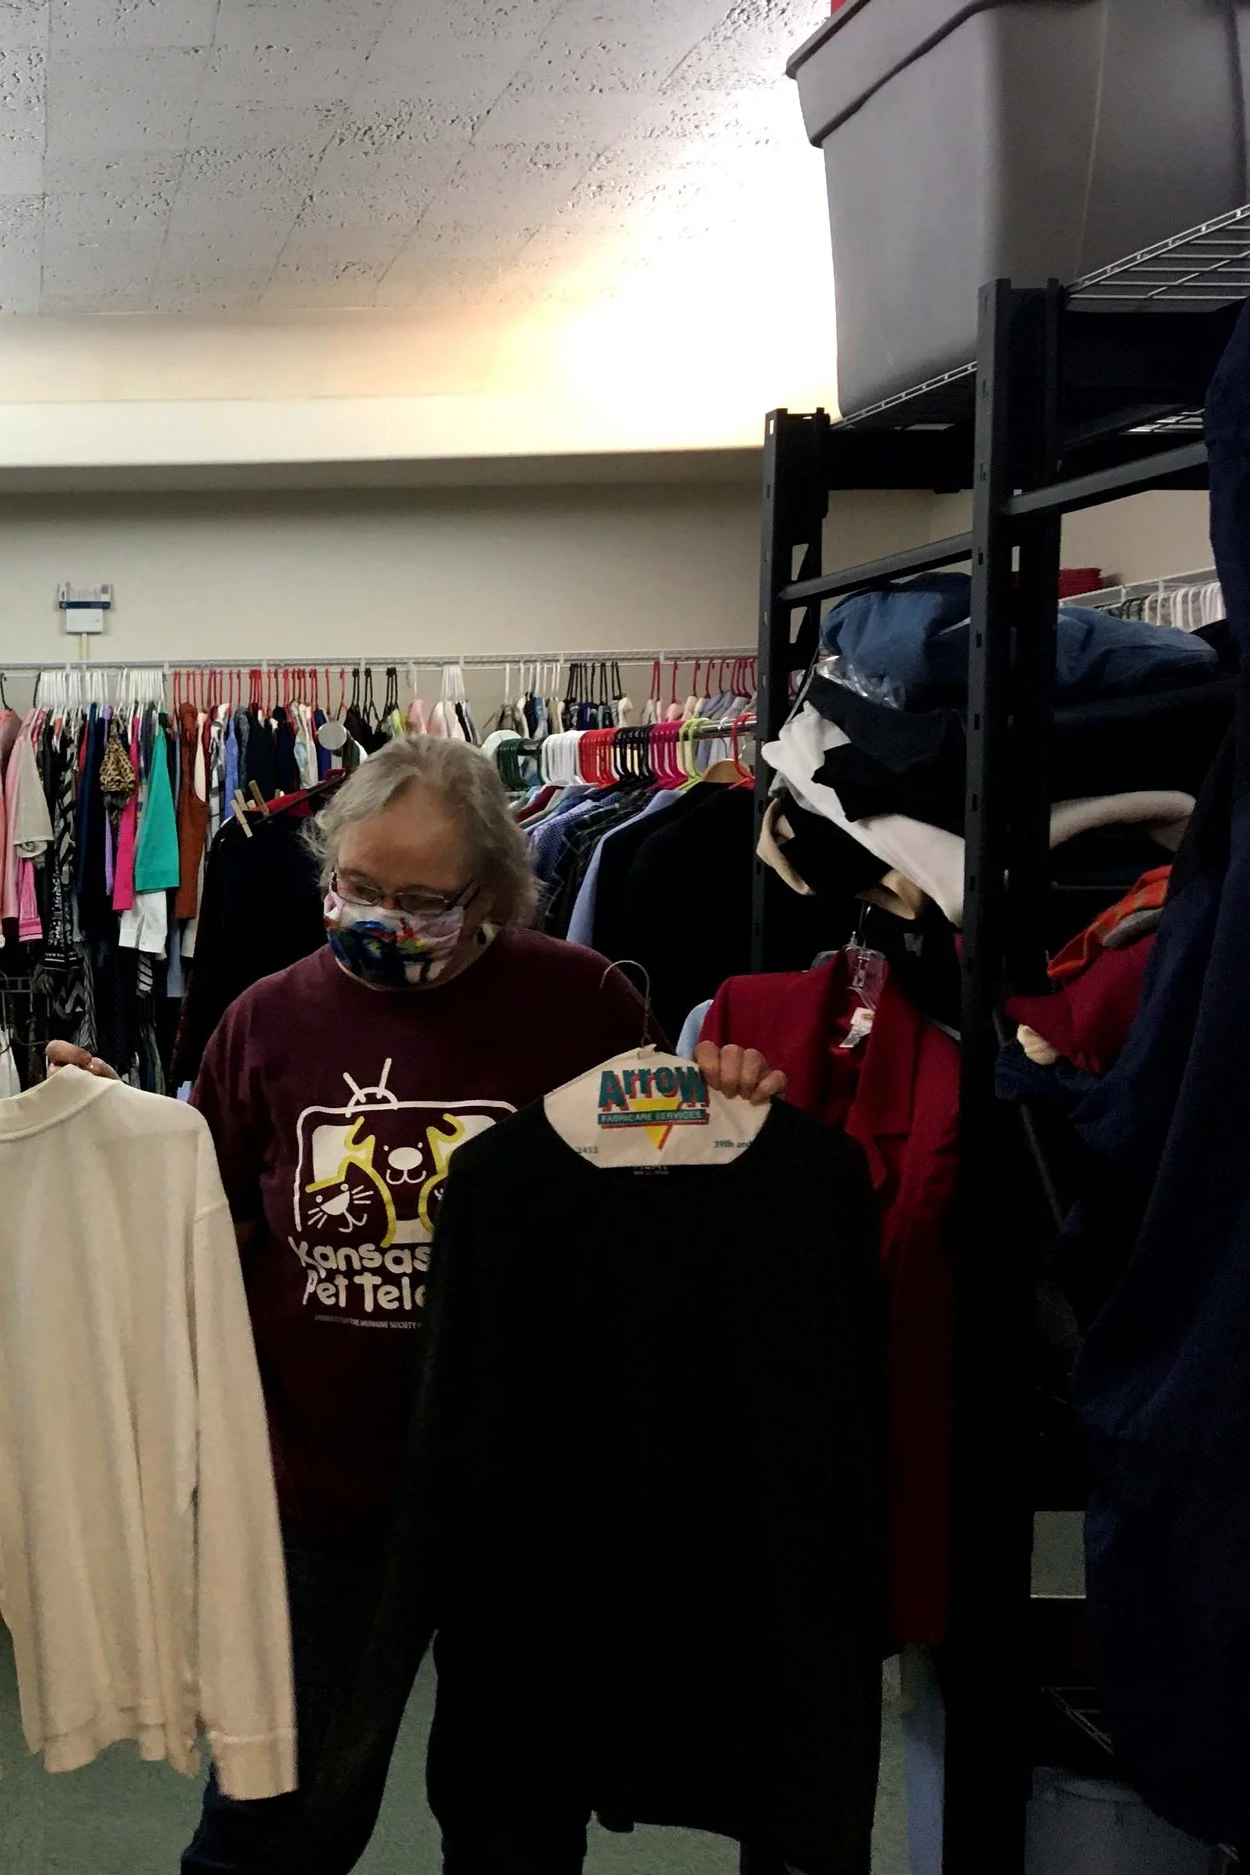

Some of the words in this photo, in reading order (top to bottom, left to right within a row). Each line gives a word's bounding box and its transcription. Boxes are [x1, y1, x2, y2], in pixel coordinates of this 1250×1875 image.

[655, 1110, 703, 1122] SERVICES
[287, 1236, 432, 1278] Kansas
[302, 1269, 349, 1309] Pet
